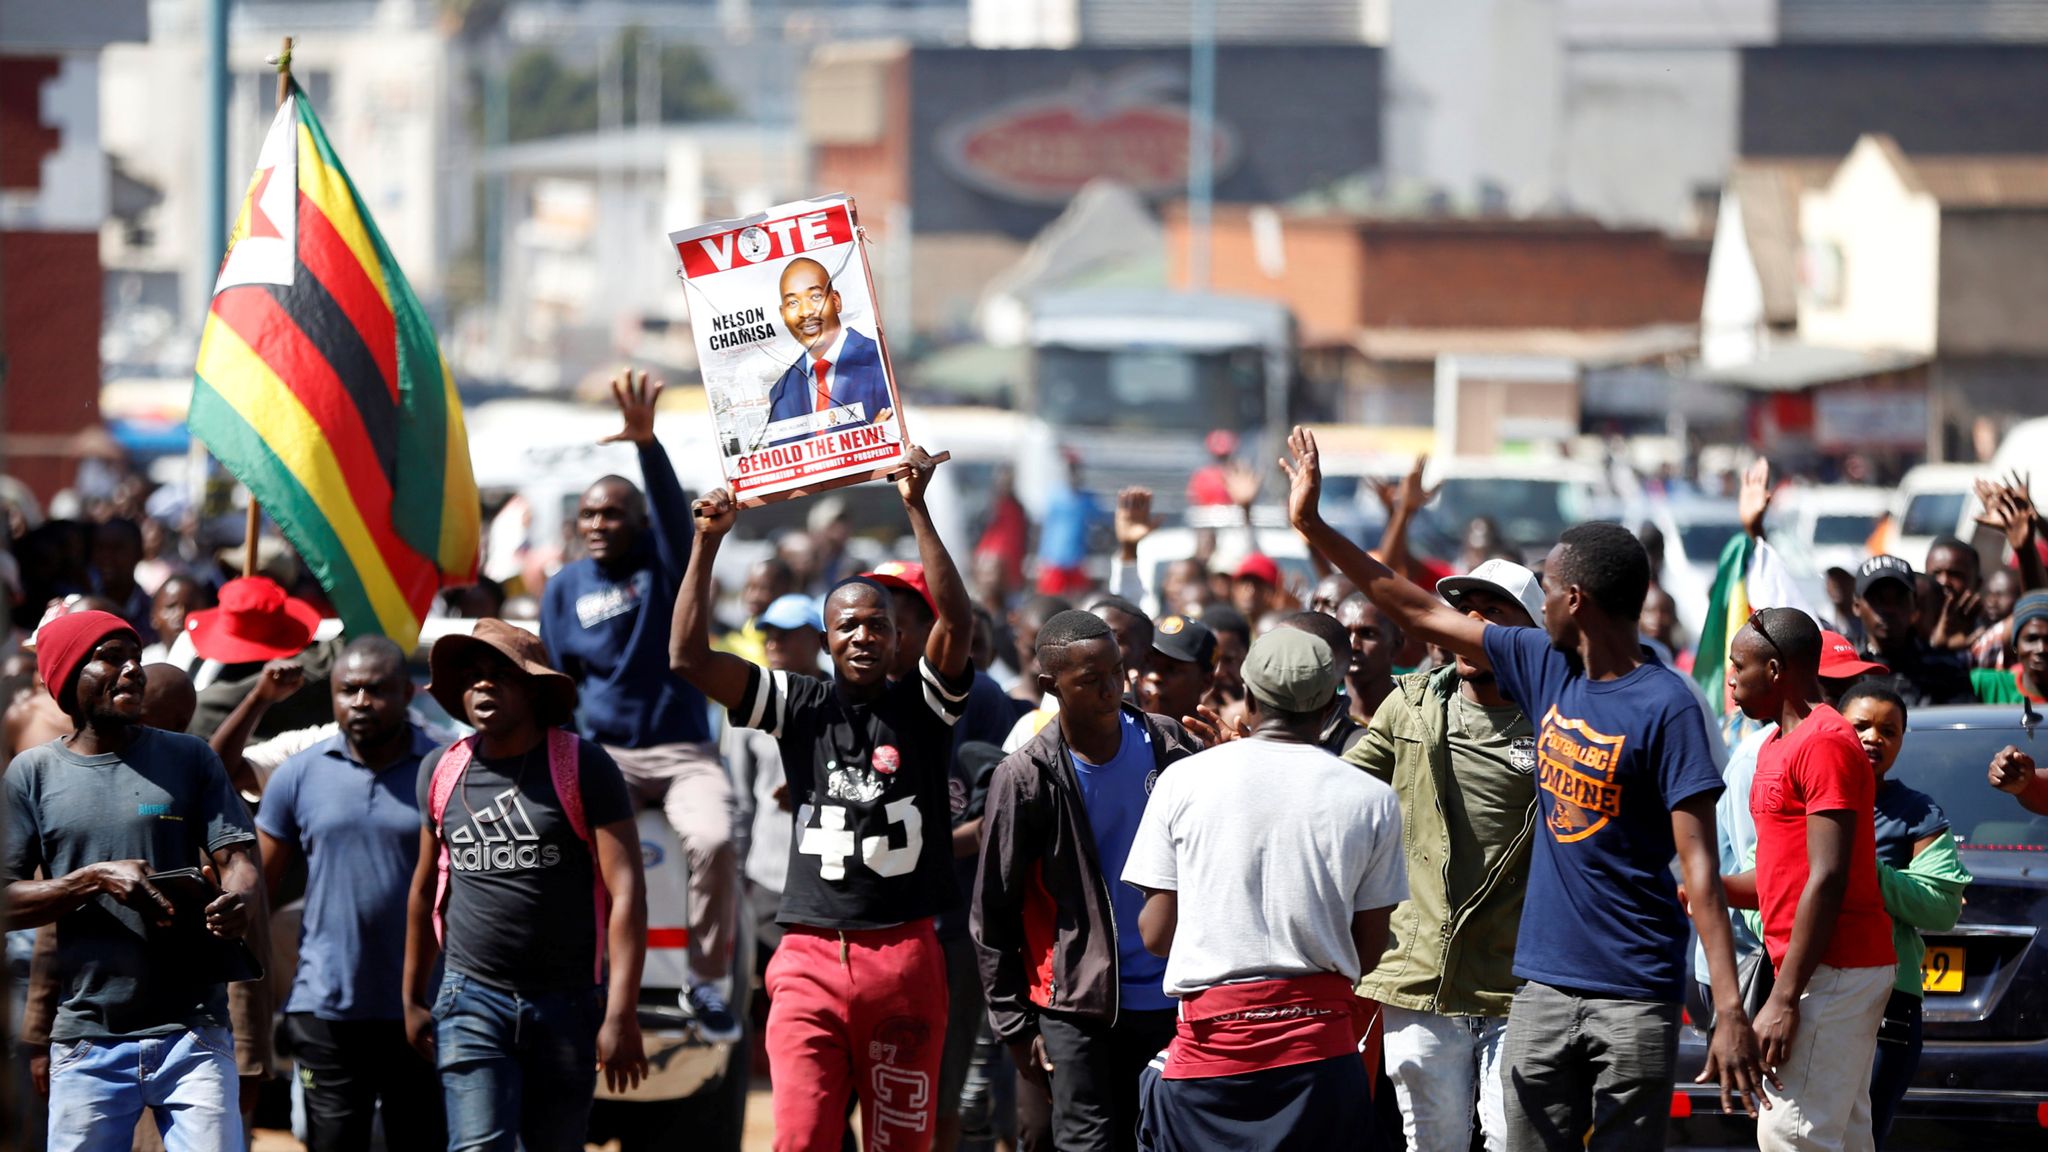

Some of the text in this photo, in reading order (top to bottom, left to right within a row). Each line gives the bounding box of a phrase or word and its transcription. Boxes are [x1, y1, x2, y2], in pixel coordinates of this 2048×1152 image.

[699, 212, 834, 271] VOTE
[712, 306, 765, 332] NELSON
[709, 322, 777, 351] CHAMISA
[738, 425, 886, 475] BEHOLD THE NEW!
[803, 455, 846, 474] OPPORTUNITY
[853, 445, 894, 462] PROSPERITY
[1539, 760, 1617, 811] OMBINE
[451, 840, 561, 872] adidas
